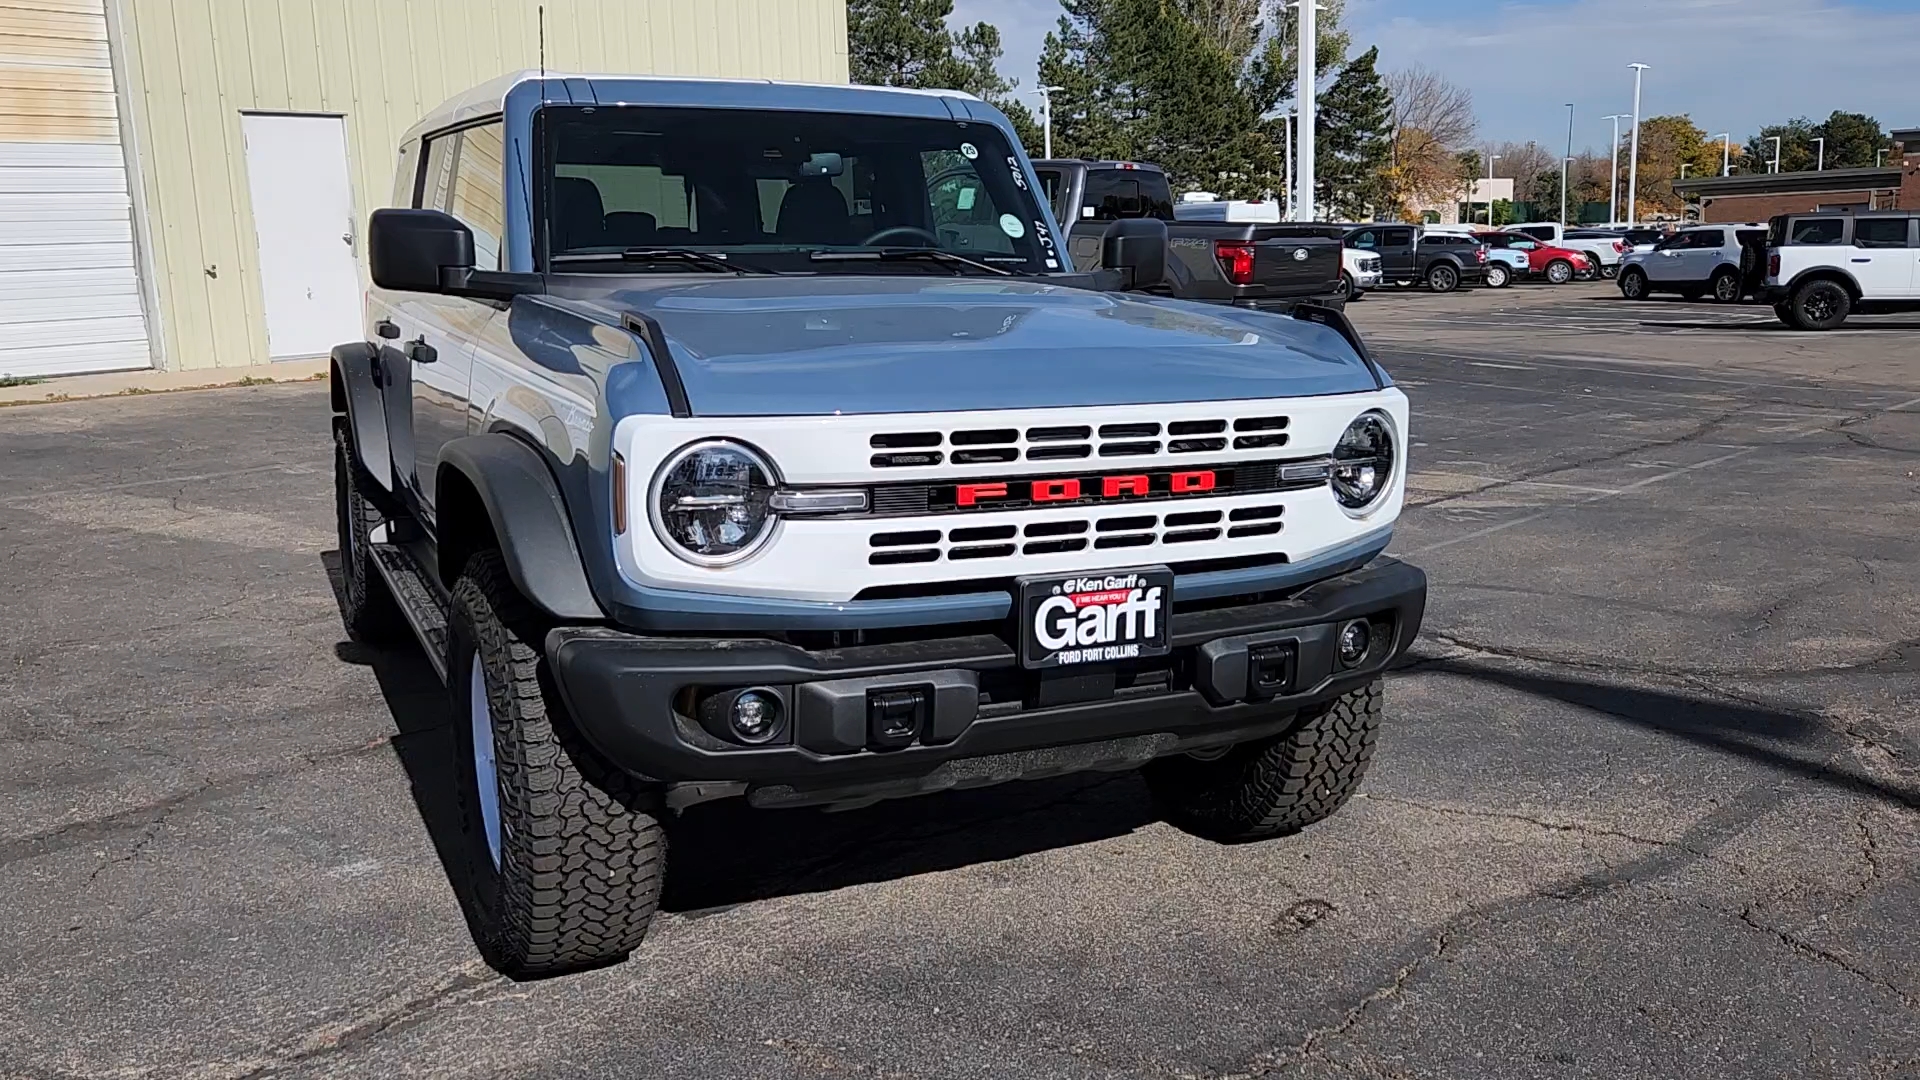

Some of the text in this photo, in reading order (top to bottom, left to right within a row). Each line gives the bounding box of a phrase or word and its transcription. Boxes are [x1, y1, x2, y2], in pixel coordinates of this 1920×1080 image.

[963, 145, 976, 155] 25
[1170, 237, 1208, 250] FX4
[956, 471, 1215, 505] FORD
[1075, 578, 1102, 592] Ken
[1103, 573, 1138, 590] Garff
[1035, 587, 1162, 650] Garff
[1059, 644, 1139, 664] FORD FORT COLLINS
